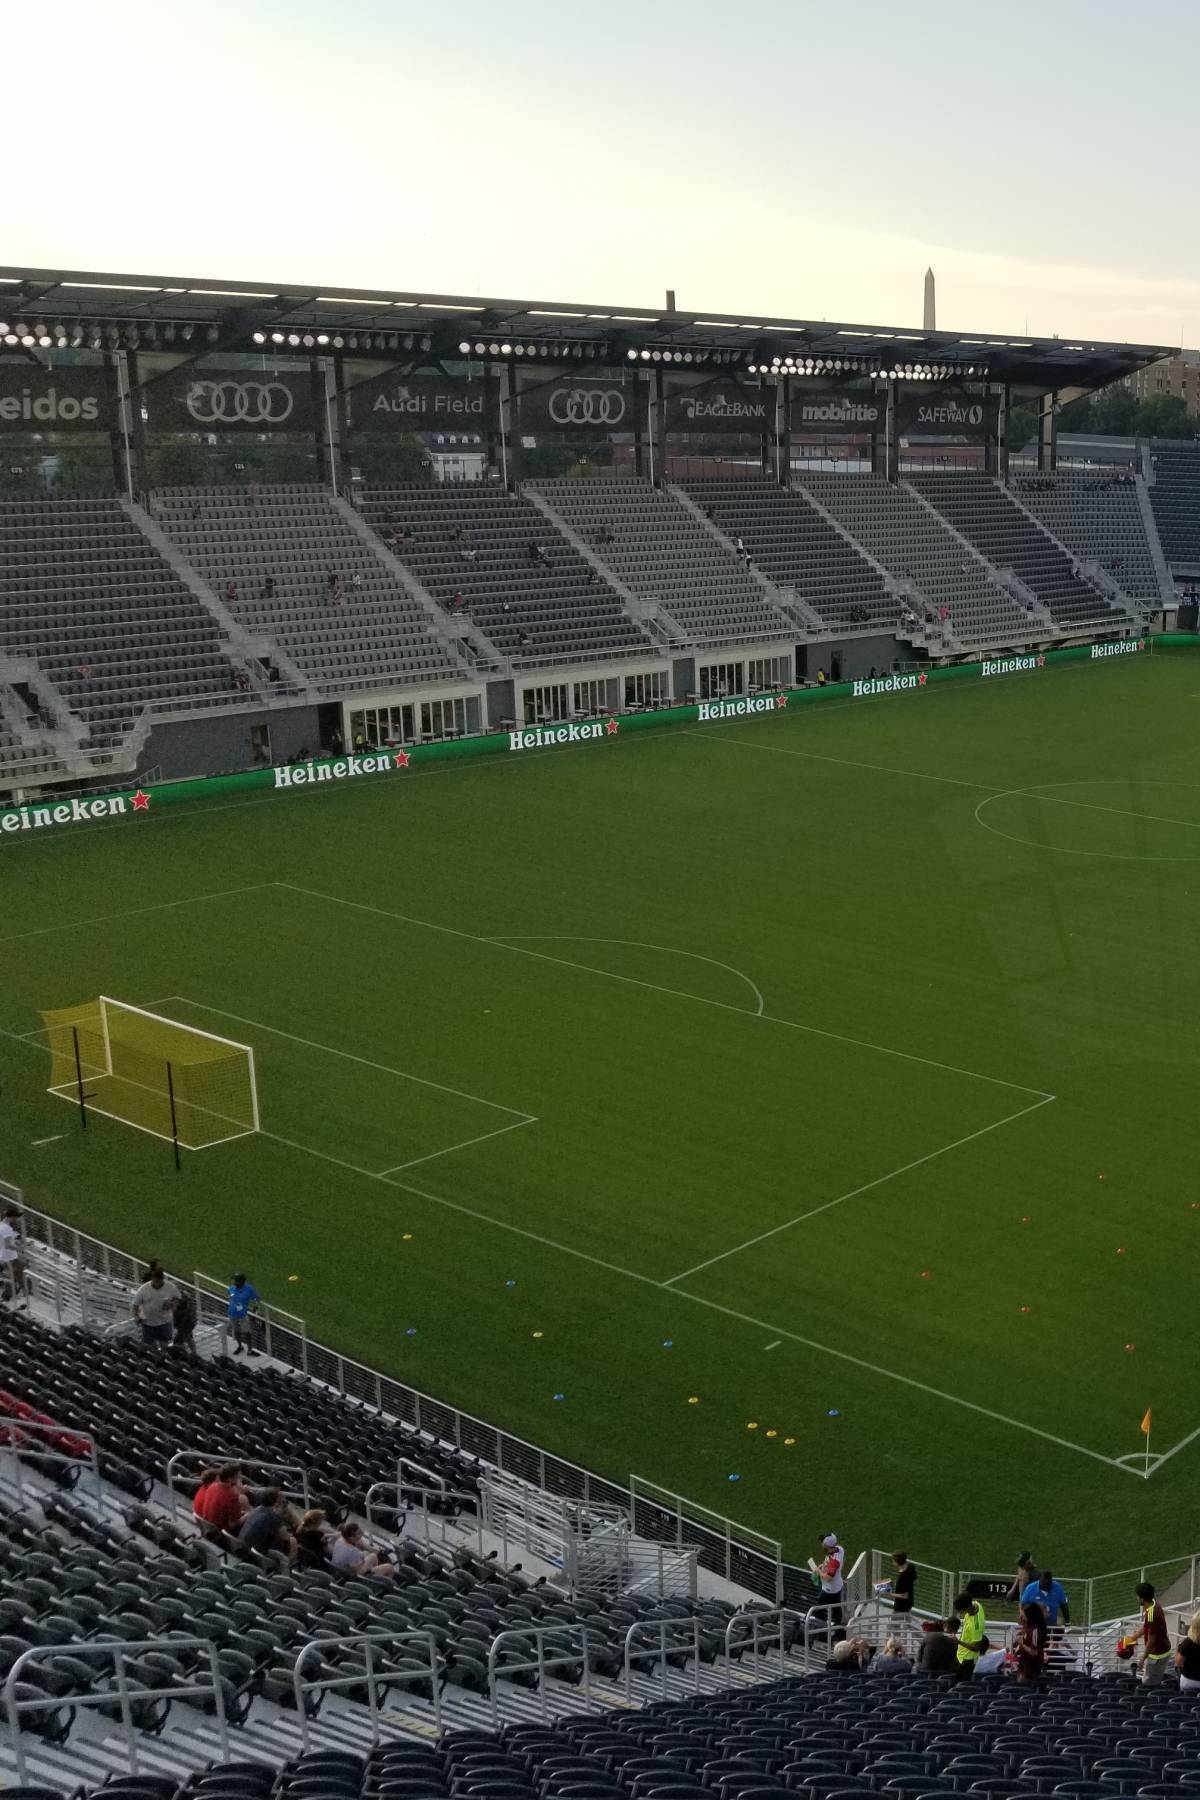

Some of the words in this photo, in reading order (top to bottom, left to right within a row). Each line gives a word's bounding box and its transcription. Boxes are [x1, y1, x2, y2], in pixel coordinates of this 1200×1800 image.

[372, 394, 427, 413] Audi
[434, 394, 483, 413] Field
[917, 405, 969, 423] SAFEWAY
[1091, 641, 1137, 659] Heineken
[981, 656, 1037, 677] Heineken
[852, 673, 917, 697] Heineken
[697, 696, 775, 721] Heineken
[508, 722, 604, 751] Heineken
[273, 754, 391, 789] Heineken
[0, 795, 127, 834] eineken
[988, 1583, 1008, 1593] 113
